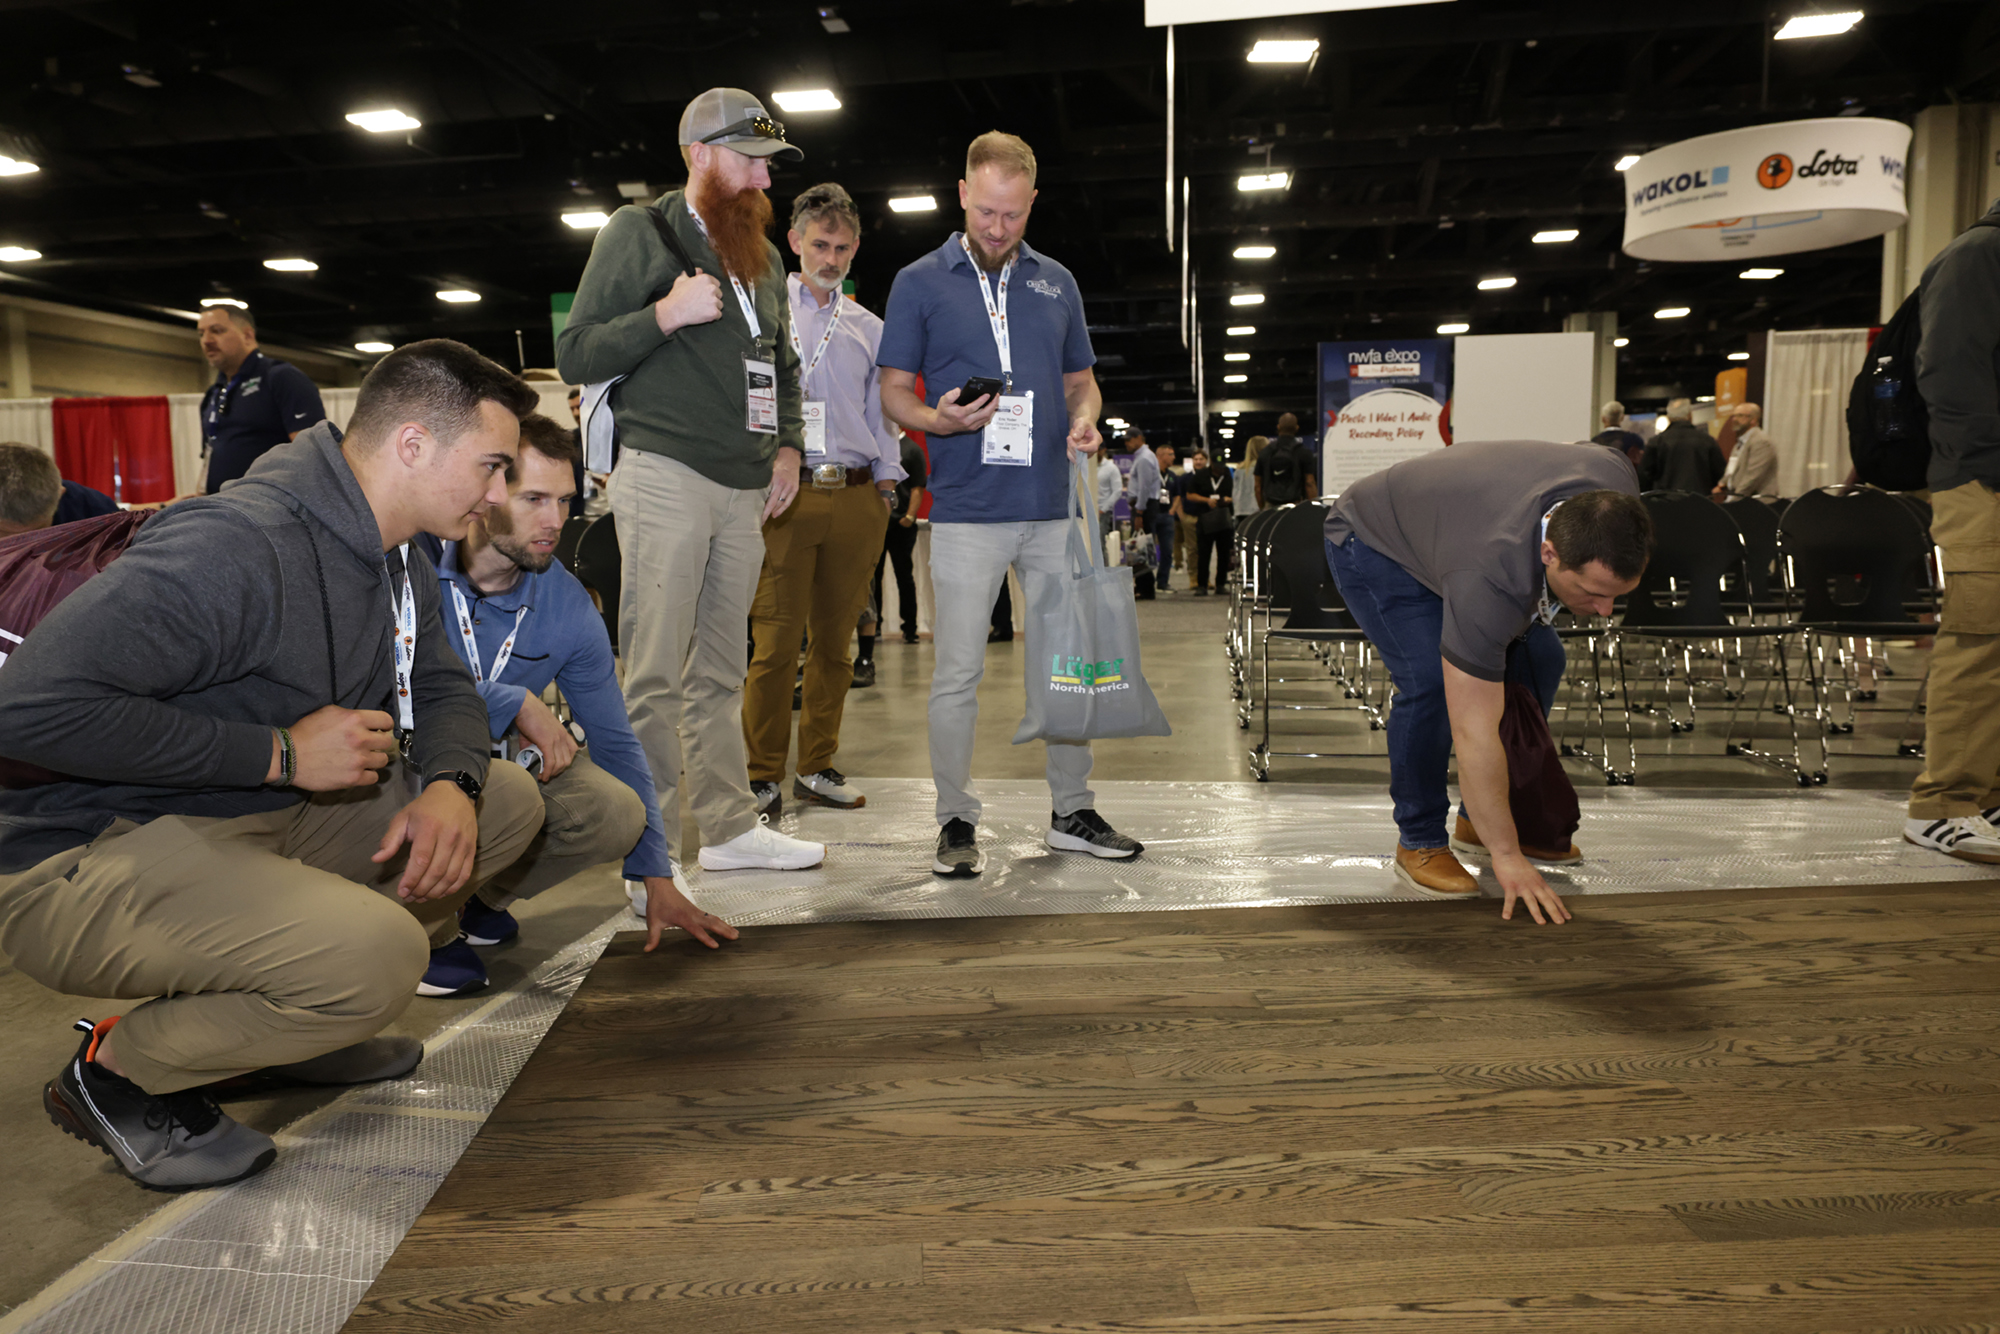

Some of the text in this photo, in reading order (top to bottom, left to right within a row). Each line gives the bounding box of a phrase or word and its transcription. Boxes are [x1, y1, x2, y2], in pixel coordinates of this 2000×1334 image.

[1798, 149, 1858, 178] Loba
[1348, 348, 1420, 365] nwfa expo
[1349, 427, 1424, 441] Recording Policy
[1050, 682, 1086, 694] North
